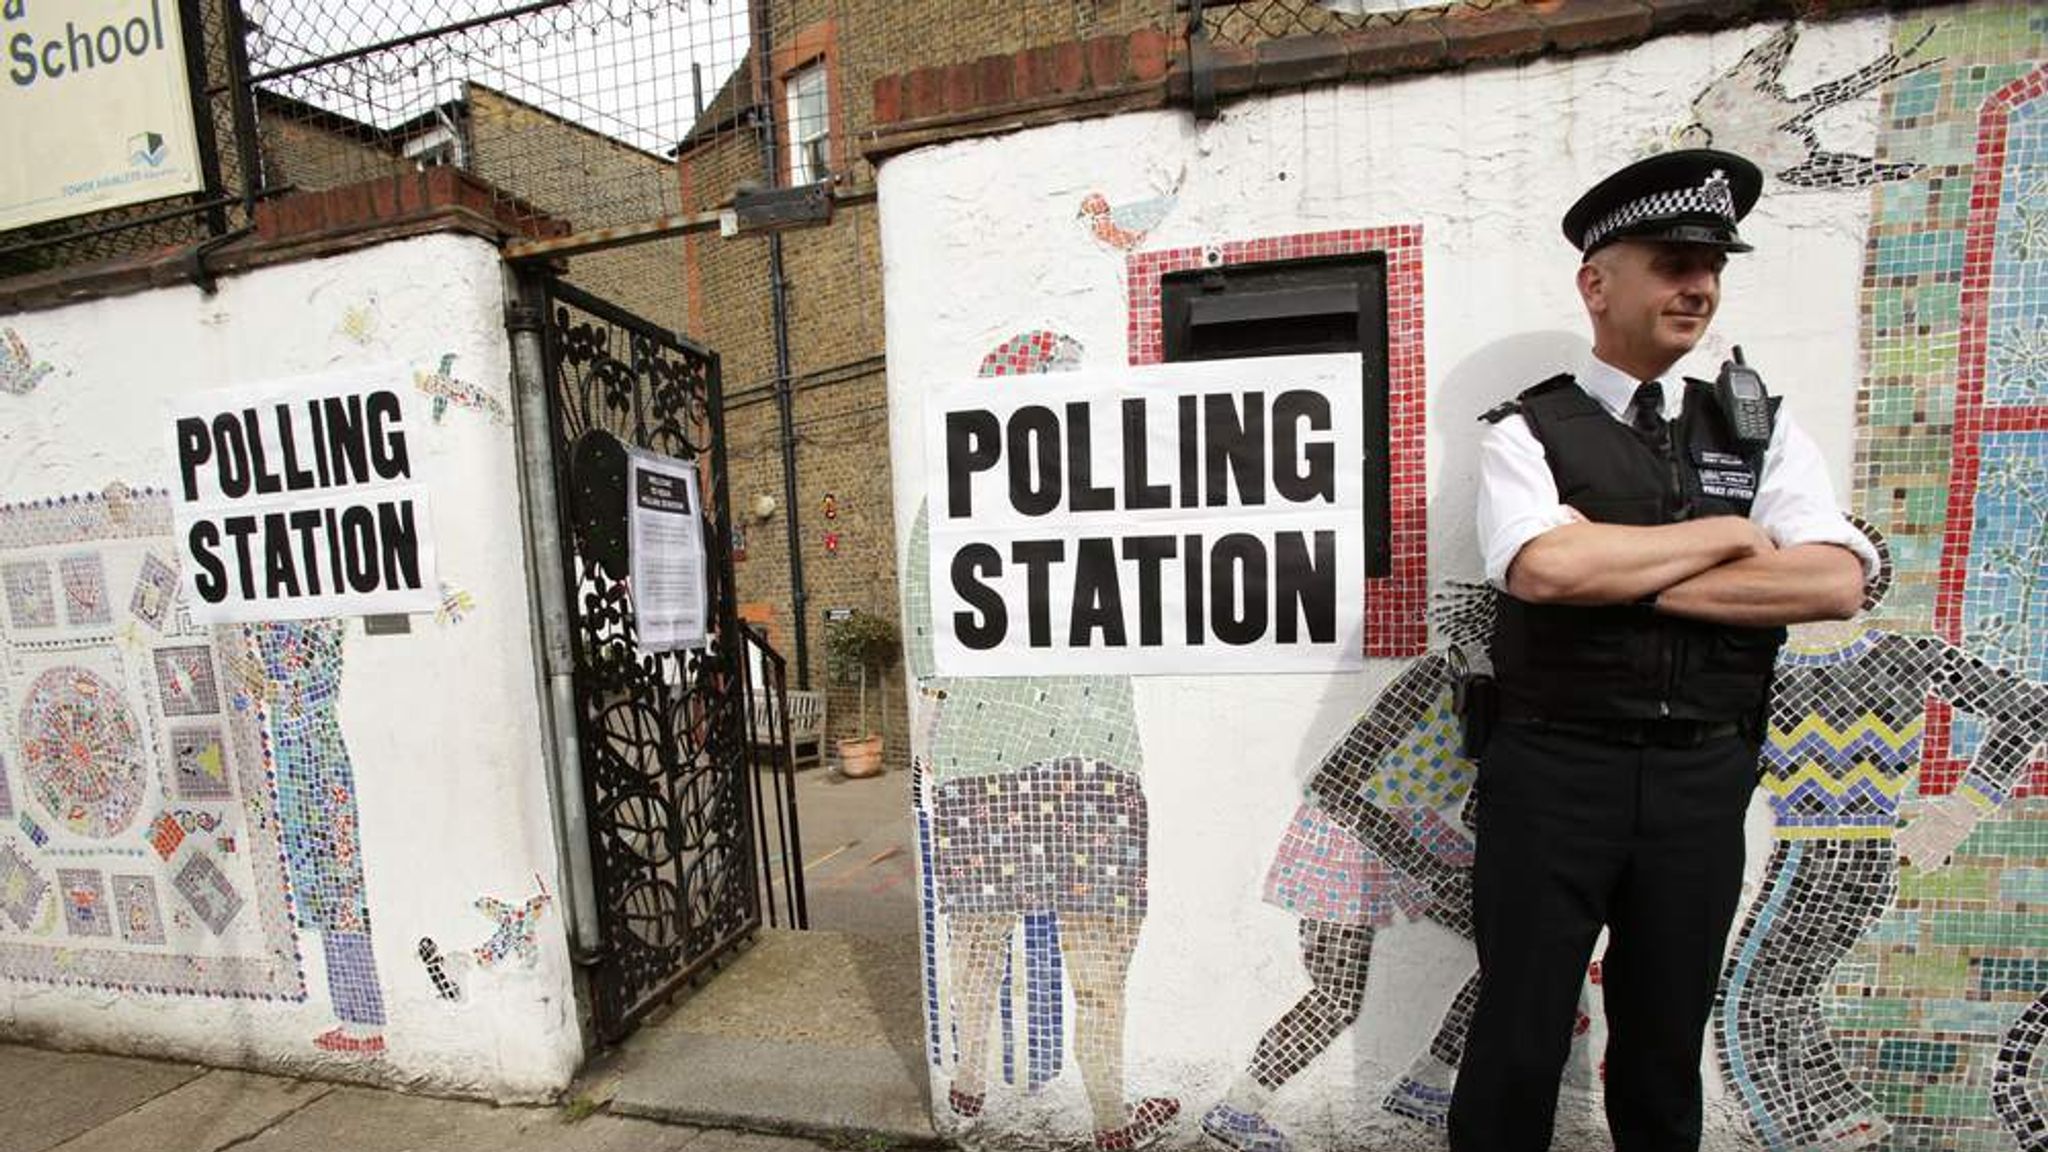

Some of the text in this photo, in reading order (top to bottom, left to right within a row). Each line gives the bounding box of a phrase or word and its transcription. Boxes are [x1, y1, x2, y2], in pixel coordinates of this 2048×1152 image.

[9, 0, 164, 86] School
[176, 390, 411, 501] POLLING
[946, 389, 1336, 519] POLLING
[188, 499, 422, 604] STATION
[950, 530, 1337, 650] STATION
